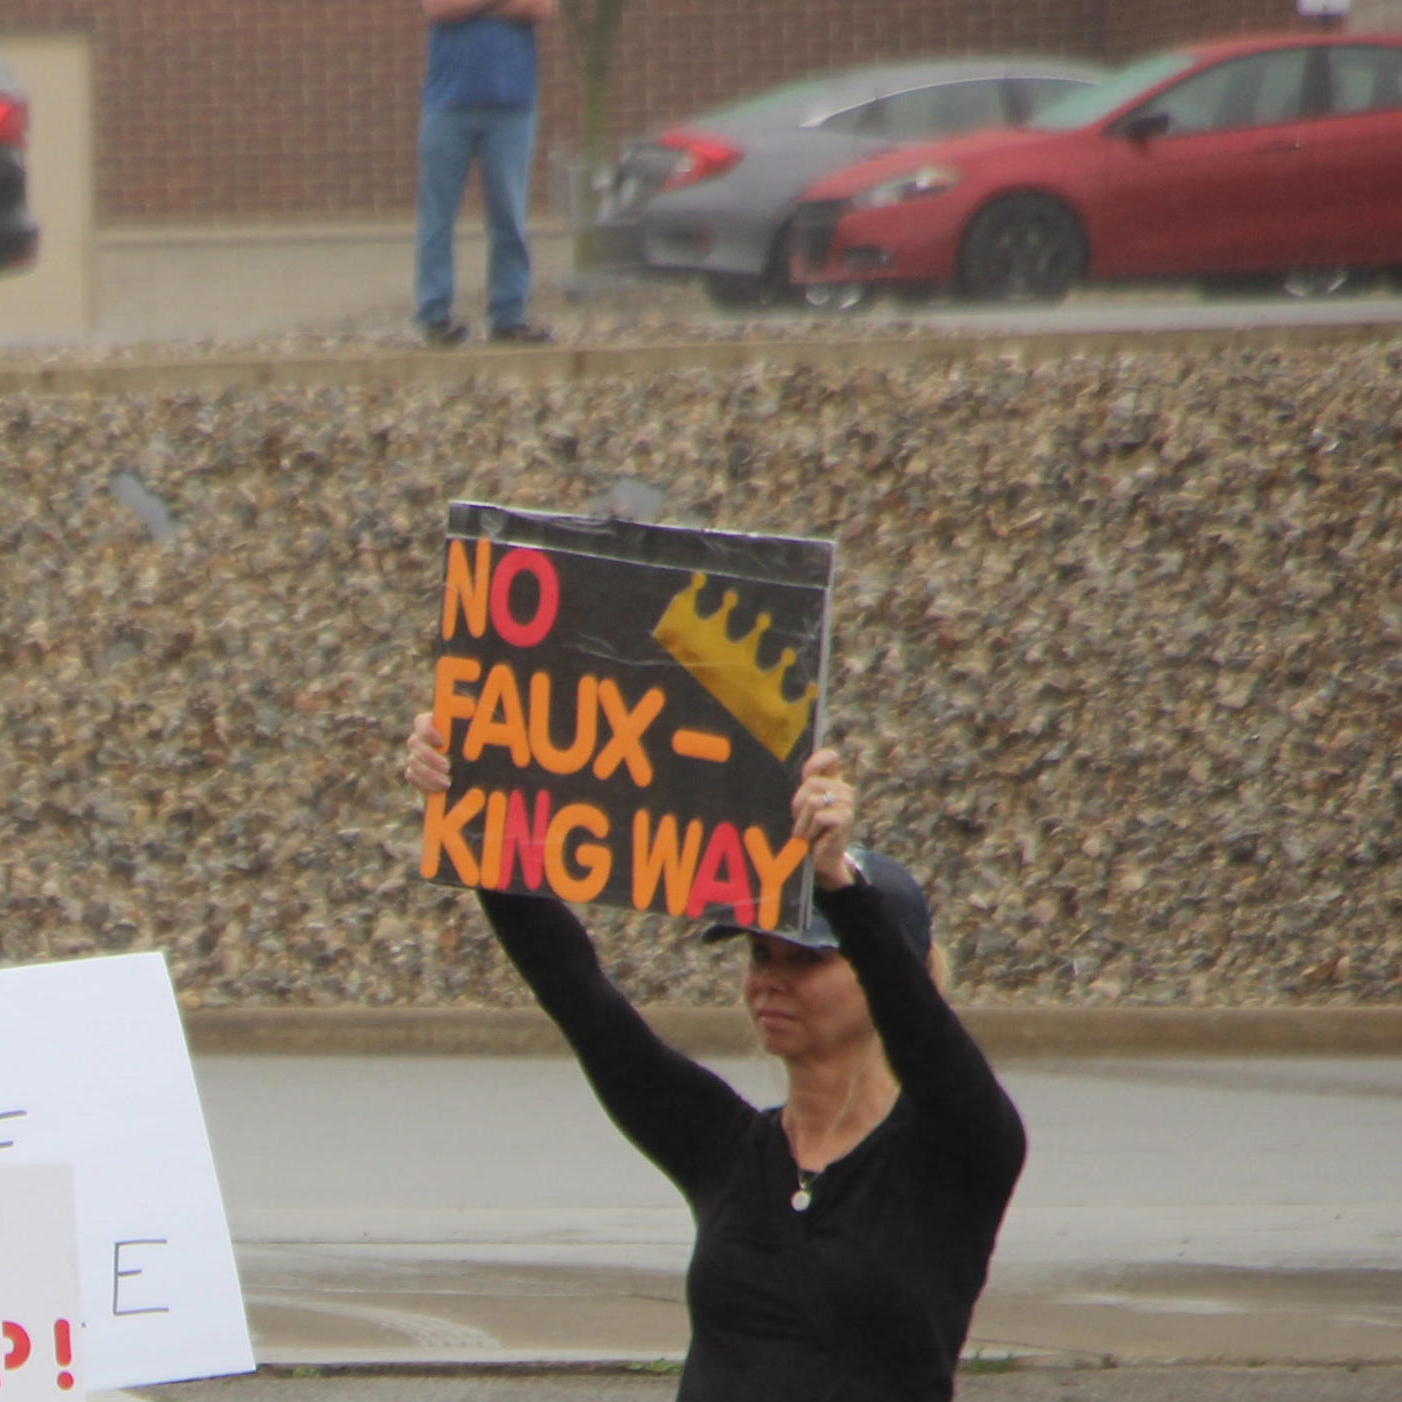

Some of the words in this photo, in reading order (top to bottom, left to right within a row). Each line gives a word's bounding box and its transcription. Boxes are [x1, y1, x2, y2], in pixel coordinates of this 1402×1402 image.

[442, 536, 559, 648] NO
[420, 788, 612, 903] KING
[633, 809, 810, 931] WAY
